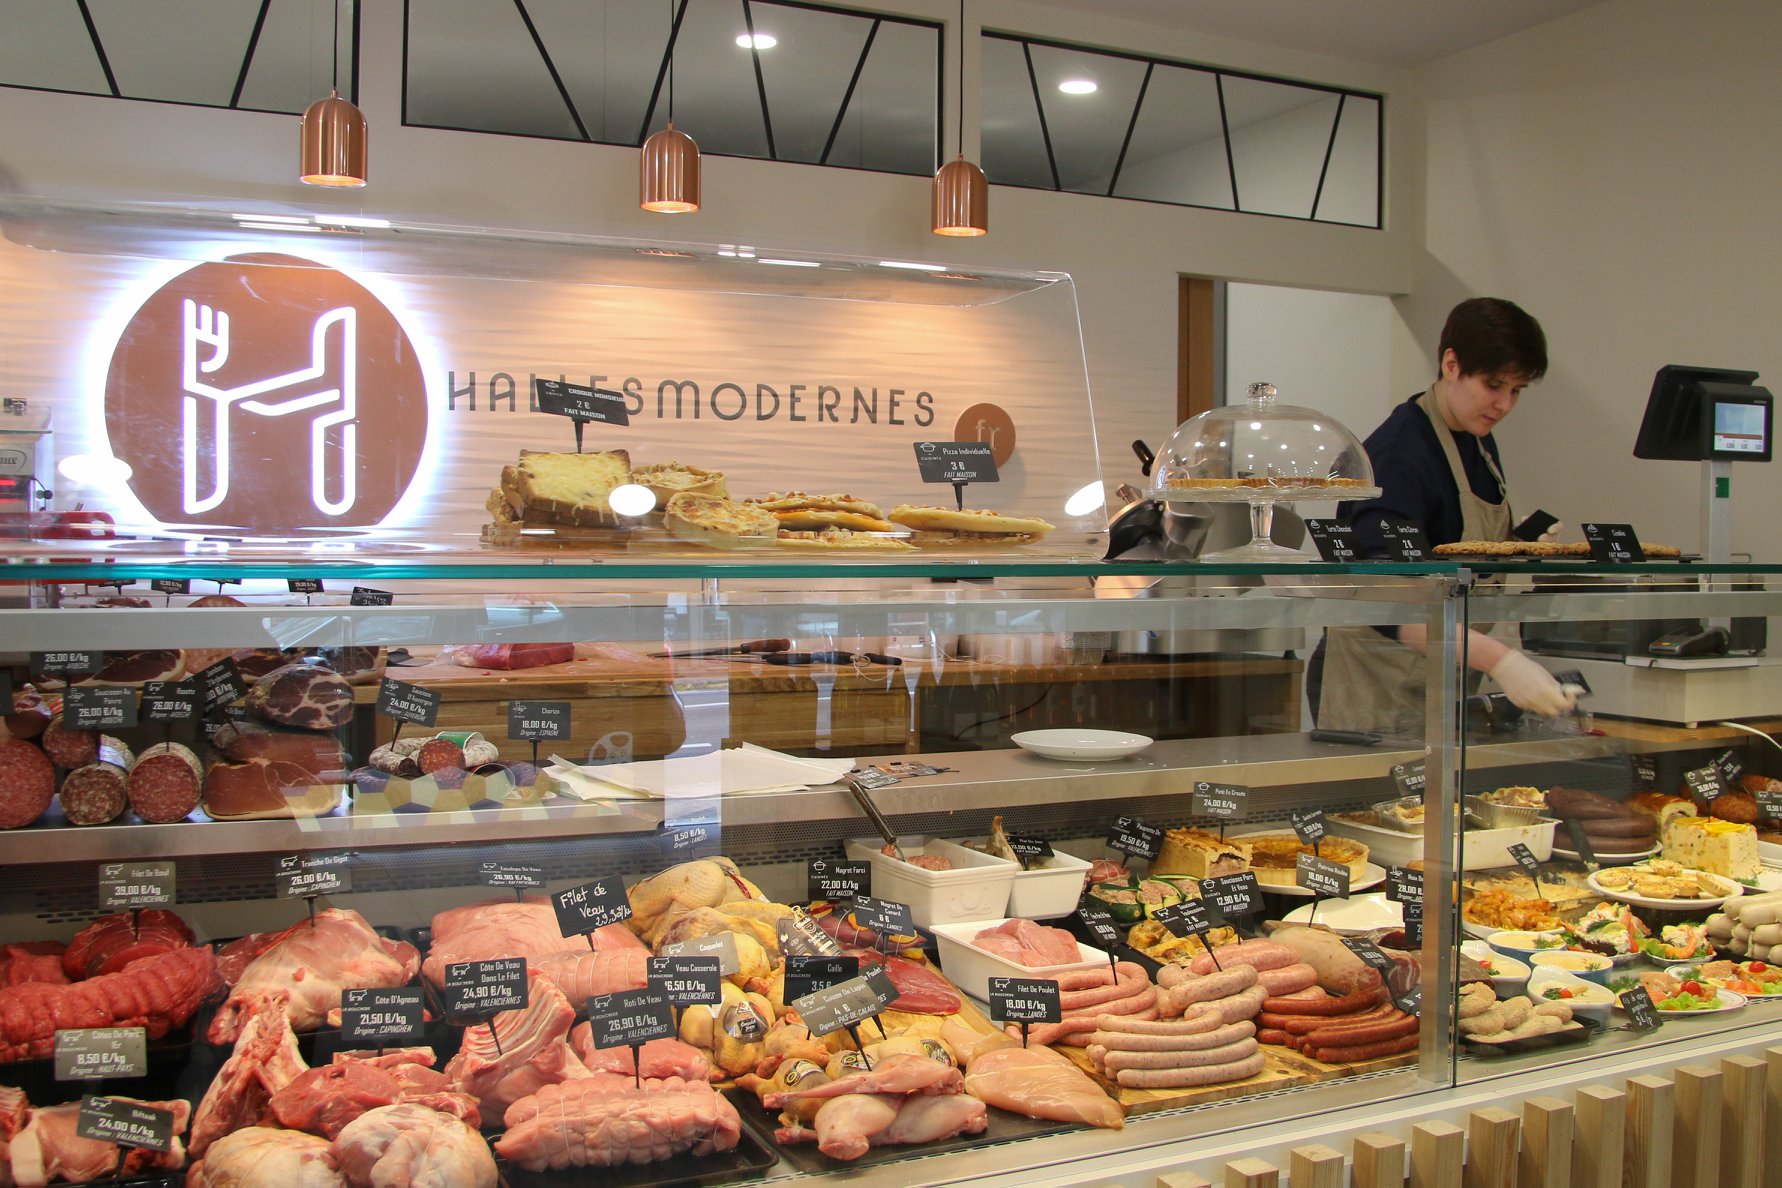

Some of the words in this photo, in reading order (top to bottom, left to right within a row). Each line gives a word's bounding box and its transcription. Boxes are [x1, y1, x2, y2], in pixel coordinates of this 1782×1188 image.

[568, 388, 593, 397] CROQUE
[577, 400, 583, 408] 2
[564, 407, 578, 415] FAIT
[580, 410, 605, 419] MAISON
[959, 447, 991, 455] Individuelle
[950, 461, 957, 469] 3
[943, 471, 955, 479] FAIT
[45, 653, 68, 661] 26,00
[70, 653, 89, 662] €/kg
[153, 701, 174, 710] 26,00
[174, 701, 192, 710] €/kg
[390, 697, 410, 710] 24,00
[410, 703, 426, 715] €/kg
[78, 707, 102, 717] 26,00
[104, 707, 123, 716] €/kg
[541, 707, 560, 715] Chorizo
[522, 720, 540, 729] 18,00
[541, 720, 558, 729] €/kg
[1203, 799, 1222, 807] 24,00
[1222, 800, 1238, 809] €/kg
[673, 831, 689, 841] 8,50
[688, 828, 706, 837] €/kg
[1120, 834, 1137, 845] 19,50
[1135, 838, 1150, 849] €/kg
[1027, 845, 1042, 853] €/kg
[301, 858, 325, 867] Tranche
[325, 858, 332, 866] De
[332, 856, 348, 865] Gigot
[131, 869, 147, 877] Filet
[147, 869, 154, 877] De
[835, 866, 852, 875] Magret
[853, 866, 866, 874] Farci
[291, 875, 315, 887] 26,00
[316, 872, 336, 882] €/kg
[514, 874, 533, 882] €/kg
[1242, 874, 1254, 882] Porc
[1308, 871, 1325, 883] 18,00
[1324, 876, 1340, 888] €/kg
[1407, 873, 1418, 881] Noix
[820, 879, 841, 889] 22,00
[842, 879, 859, 889] €/kg
[1397, 883, 1417, 894] 28,00
[115, 885, 140, 896] 39,00
[141, 885, 161, 895] €/kg
[287, 886, 308, 896] Origine
[560, 887, 588, 908] Filet
[593, 882, 607, 896] de
[825, 889, 836, 897] FAIT
[836, 889, 854, 897] MAISON
[106, 896, 127, 905] Origine
[130, 895, 171, 904] VALENCIENNES
[1216, 895, 1233, 906] 12,90
[1233, 892, 1251, 903] €/kg
[880, 901, 897, 909] Magret
[1223, 904, 1232, 912] FAIT
[1232, 903, 1249, 911] MAISON
[579, 903, 605, 918] Veau
[885, 907, 901, 916] Canard
[1184, 917, 1191, 925] 2
[886, 923, 903, 931] LANDES
[699, 942, 724, 952] Coquelet
[480, 961, 496, 972] Côte
[495, 962, 504, 970] De
[504, 961, 521, 969] Veau
[675, 964, 690, 972] Veau
[690, 963, 717, 971] Casserole
[827, 963, 843, 972] Caille
[481, 973, 497, 983] Dans
[498, 973, 506, 981] Le
[506, 971, 520, 980] Filet
[867, 967, 882, 978] Poulet
[686, 980, 706, 992] €/kg
[1017, 983, 1029, 992] Filet
[1029, 984, 1038, 993] De
[1038, 985, 1056, 993] Poulet
[462, 986, 488, 999] 24,90
[490, 985, 512, 997] €/kg
[678, 991, 715, 1000] VALENCIENNES
[822, 991, 842, 1004] Cuisse
[842, 988, 852, 998] De
[851, 984, 867, 996] Lapin
[375, 994, 391, 1005] Côte
[391, 995, 420, 1006] D'Agneau
[454, 1001, 476, 1011] Origine
[480, 995, 522, 1008] VALENCIENNES
[623, 998, 638, 1007] Roti
[637, 997, 647, 1006] De
[647, 995, 663, 1005] Veau
[1005, 998, 1026, 1009] 18,00
[1027, 999, 1047, 1011] €/kg
[834, 1006, 841, 1015] 4
[838, 1004, 877, 1022] PAS-DE-CALAIS
[1005, 1009, 1025, 1018] Origine
[1026, 1010, 1048, 1018] LANDES
[359, 1013, 384, 1025] 21,50
[385, 1012, 407, 1025] €/kg
[607, 1017, 635, 1031] 26,90
[635, 1014, 658, 1028] €/kg
[92, 1030, 112, 1039] Côtes
[112, 1030, 121, 1038] De
[353, 1026, 376, 1036] Origine
[379, 1024, 413, 1034] CAPINGHEM
[602, 1033, 624, 1045] Origine
[627, 1024, 669, 1039] VALENCIENNES
[76, 1052, 101, 1064] 8,50
[102, 1052, 126, 1064] €/kg
[97, 1117, 128, 1131] 24,00
[129, 1124, 155, 1137] €/kg
[115, 1132, 165, 1147] VALENCIENNES
